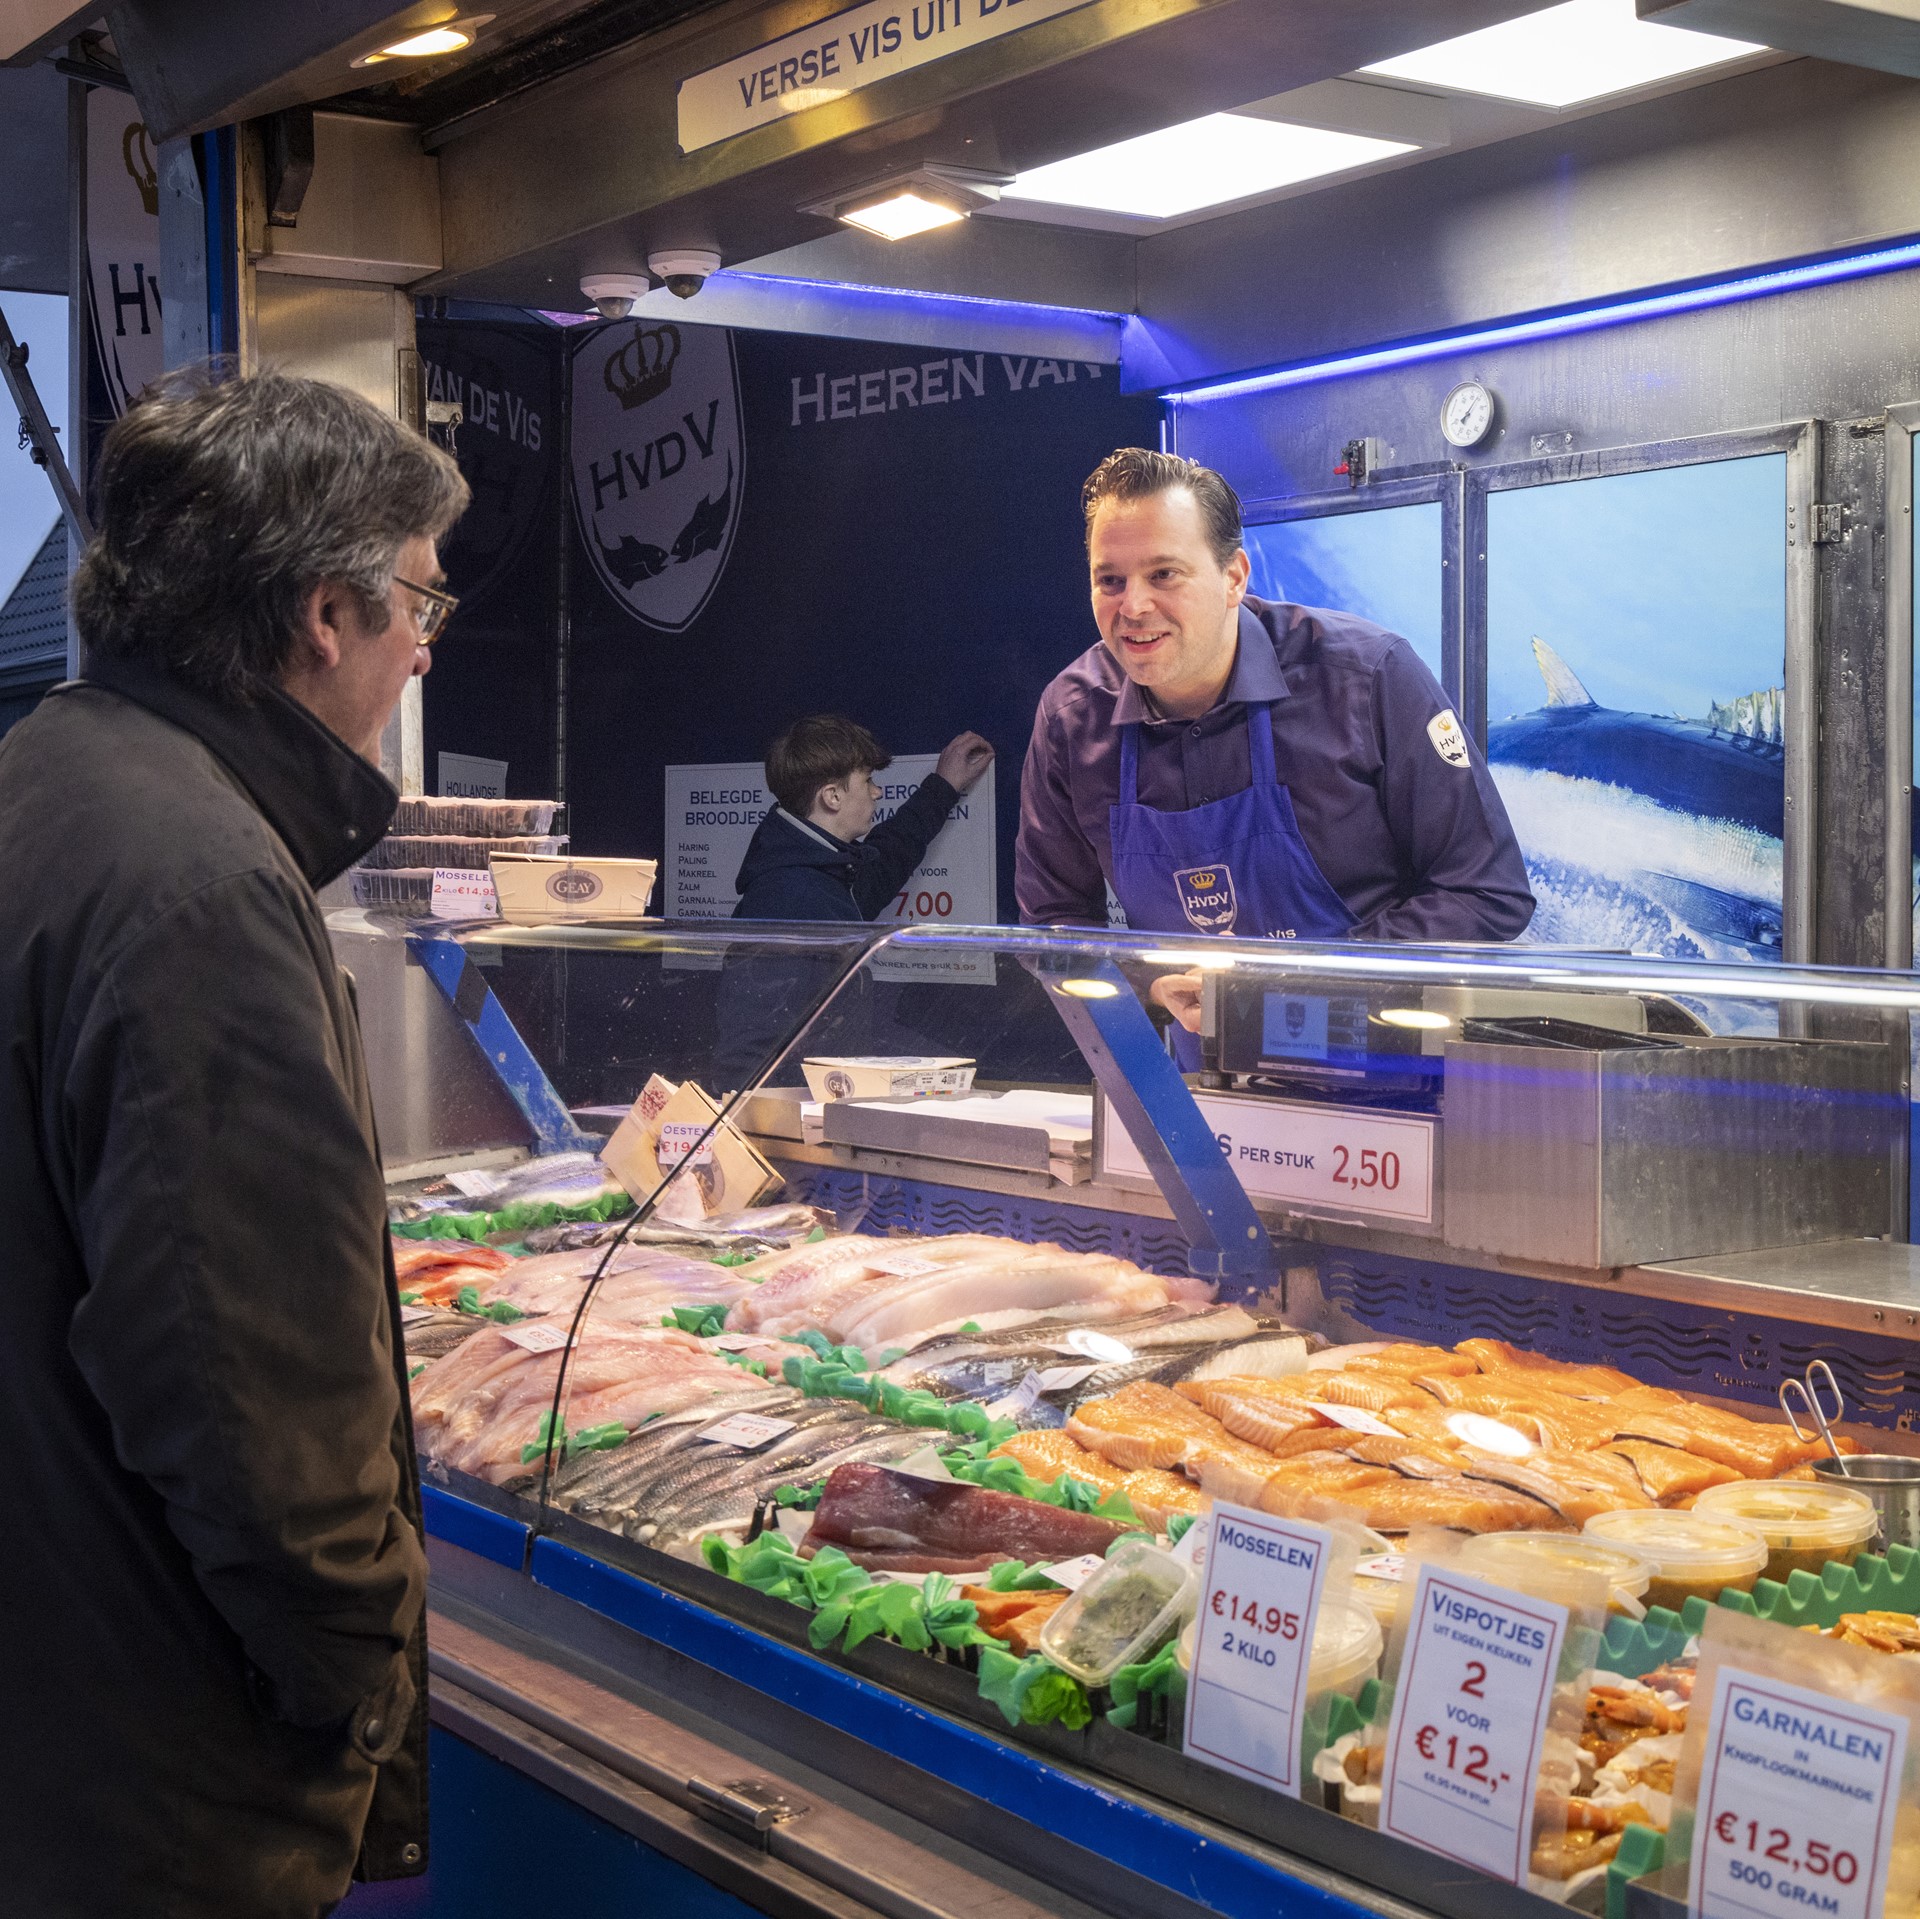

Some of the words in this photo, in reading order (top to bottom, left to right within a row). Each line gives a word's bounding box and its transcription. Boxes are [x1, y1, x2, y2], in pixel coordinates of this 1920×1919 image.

[738, 38, 840, 108] VERSE
[849, 16, 902, 65] VIS
[912, 0, 961, 41] UIT
[790, 354, 985, 426] HEEREN
[469, 382, 500, 434] DE
[504, 391, 541, 451] VIS
[690, 789, 763, 805] BELEGDE
[685, 811, 767, 825] BROODJES
[678, 842, 710, 852] HARING
[678, 856, 708, 865] PALING
[435, 870, 492, 881] MOSSELE
[556, 880, 592, 894] GEAY
[678, 869, 717, 878] MAKREEL
[678, 882, 700, 891] ZALM
[920, 868, 948, 877] VOOR
[434, 884, 442, 893] 2
[678, 896, 717, 905] GARNAAL
[678, 908, 717, 918] GARNAAL
[894, 891, 953, 921] 7,00
[1239, 1146, 1270, 1164] PER
[1274, 1150, 1315, 1170] STUK
[1332, 1144, 1401, 1191] 2,50
[1219, 1524, 1314, 1570] MOSSELEN
[1211, 1590, 1300, 1641] €14,95
[1432, 1590, 1546, 1650] VISPOTJES
[1222, 1632, 1235, 1652] 2
[1238, 1640, 1276, 1667] KILO
[1433, 1623, 1451, 1638] UIT
[1452, 1629, 1484, 1650] EIGEN
[1486, 1643, 1533, 1668] KEUKEN
[1460, 1660, 1488, 1699] 2
[1446, 1703, 1492, 1733] VOOR
[1733, 1697, 1884, 1763] GARNALEN
[1793, 1749, 1810, 1763] IN
[1724, 1743, 1875, 1804] KNOFLOOKMARINADE
[1714, 1811, 1859, 1886] €12,50
[1729, 1859, 1773, 1890] 500
[1777, 1880, 1840, 1915] GRAM
